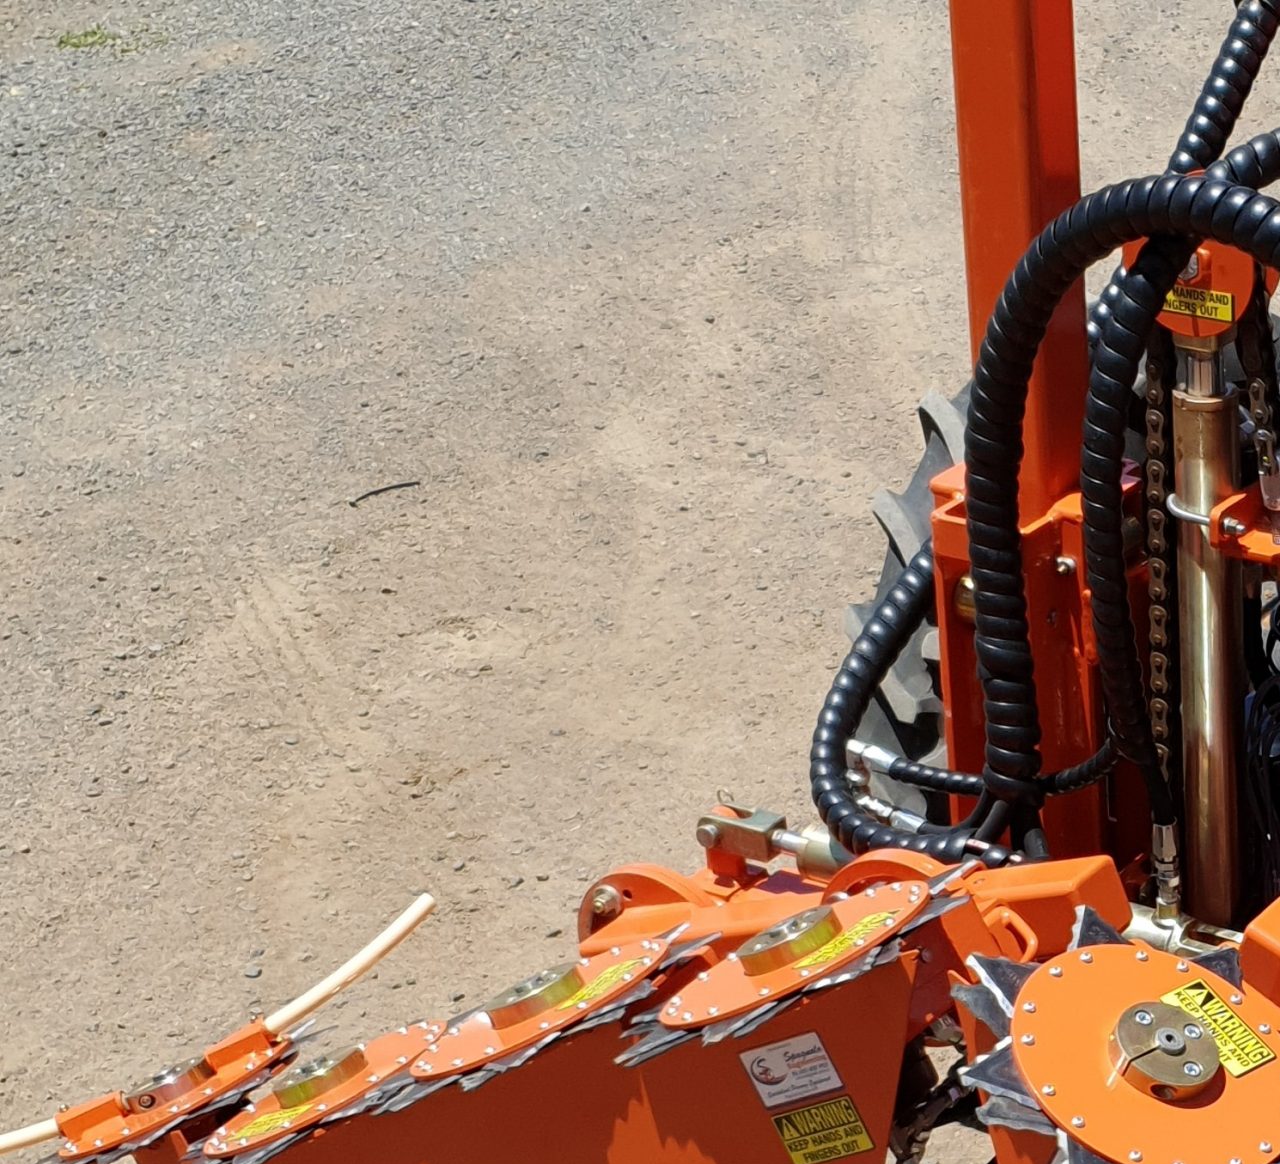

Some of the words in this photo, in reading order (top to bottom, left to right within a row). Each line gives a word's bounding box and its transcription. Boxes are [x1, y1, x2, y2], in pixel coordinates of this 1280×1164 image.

[1164, 299, 1196, 313] NGERS
[1200, 305, 1218, 317] OUT
[1173, 287, 1205, 302] HANDS
[1210, 294, 1229, 305] AND
[1174, 991, 1199, 1013] KEEP
[1199, 1016, 1227, 1046] HANDS
[1228, 1048, 1250, 1067] AND
[1202, 1001, 1270, 1063] WARNING
[790, 1100, 855, 1135] WARNING
[787, 1139, 809, 1152] KEEP
[810, 1130, 843, 1147] HANDS
[843, 1125, 863, 1138] AND
[803, 1145, 841, 1162] FINGERS
[841, 1140, 860, 1153] OUT
